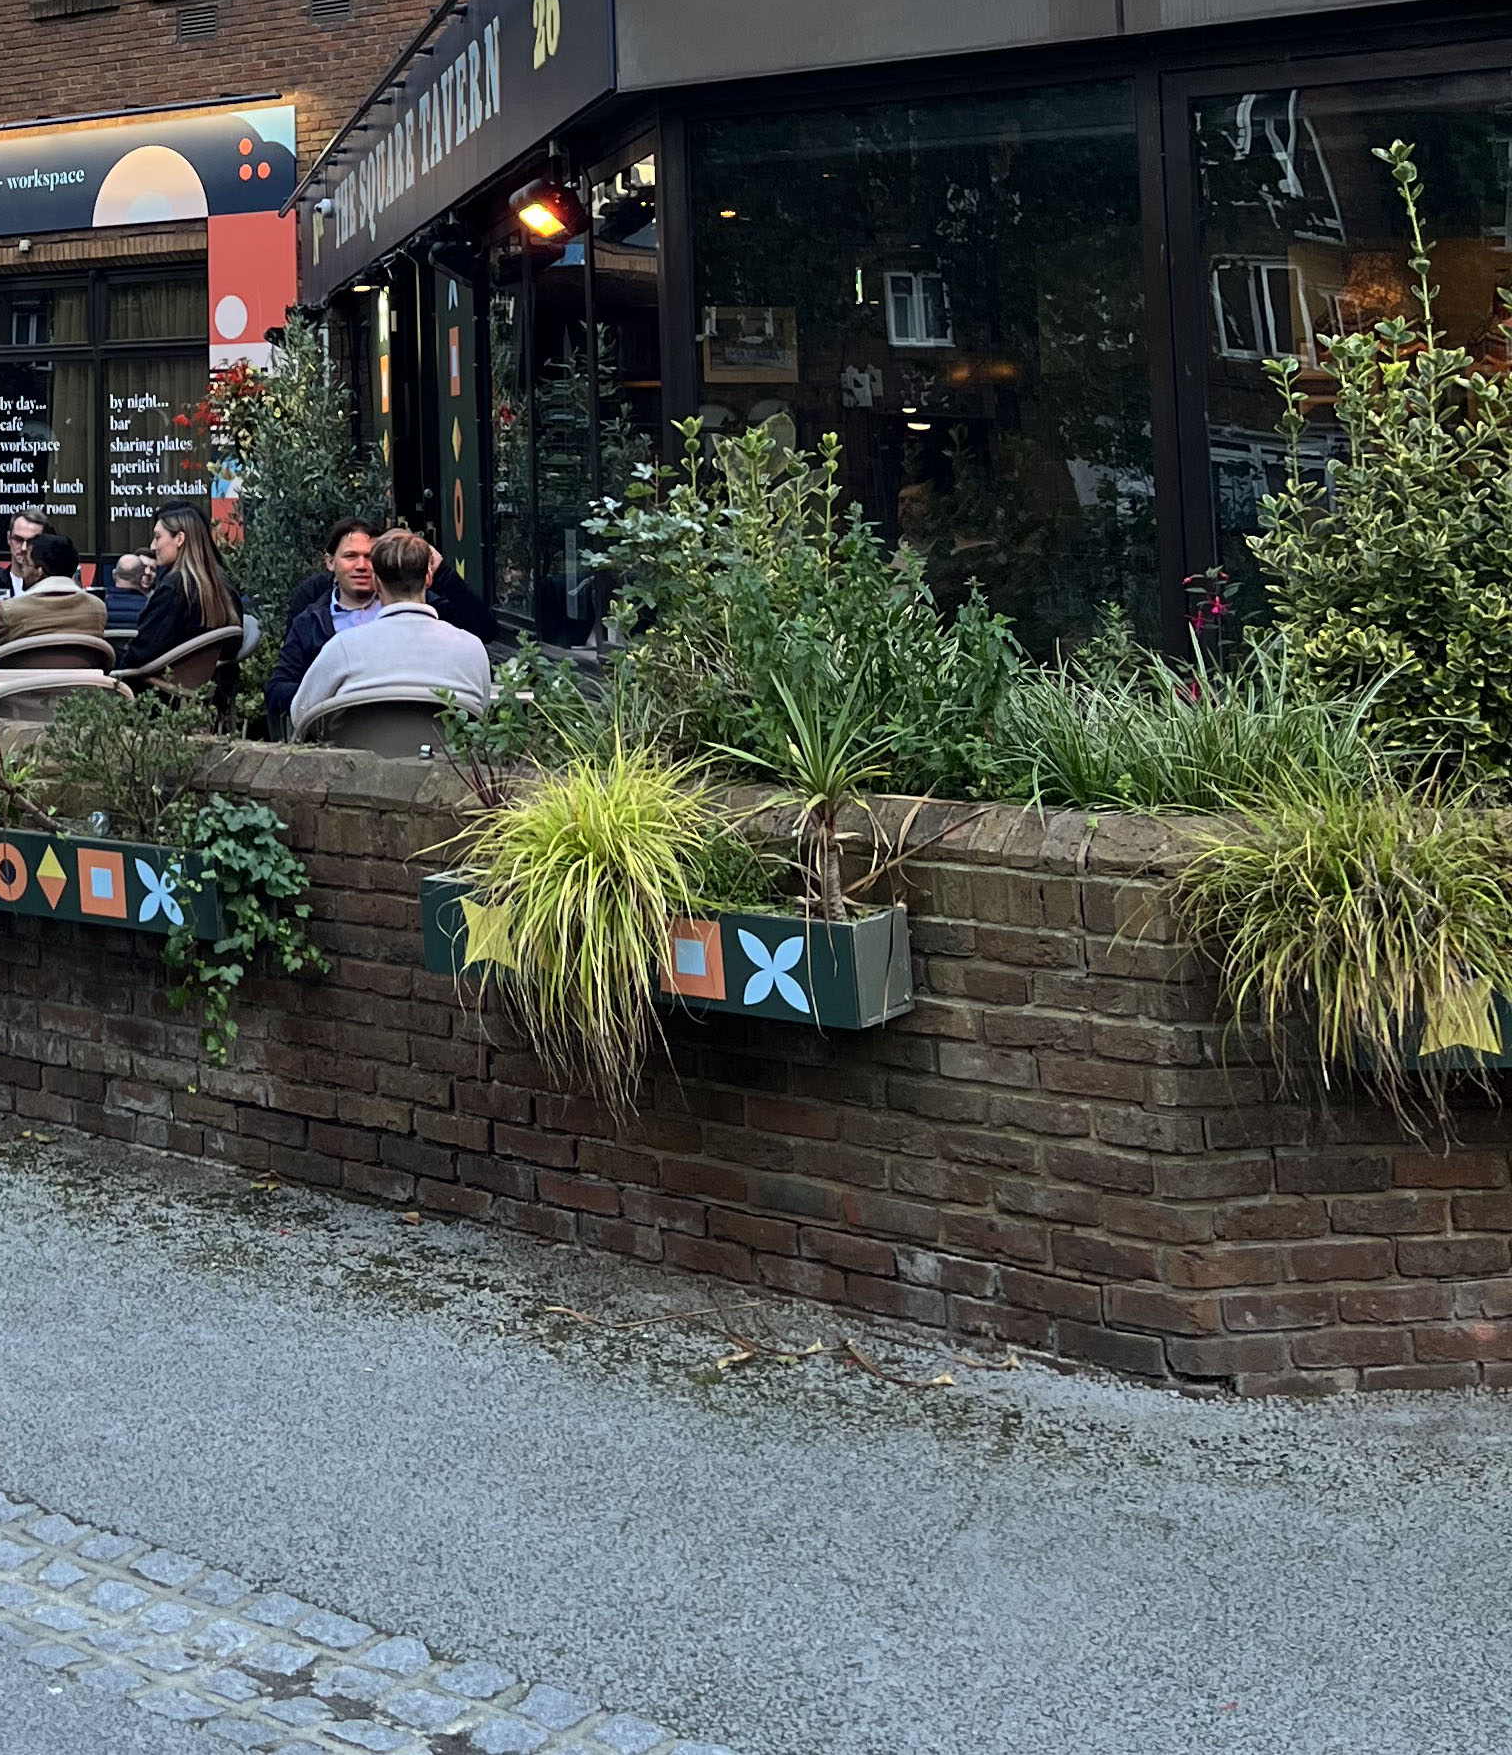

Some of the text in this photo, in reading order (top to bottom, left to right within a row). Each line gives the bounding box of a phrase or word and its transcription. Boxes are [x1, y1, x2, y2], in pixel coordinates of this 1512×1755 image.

[334, 15, 501, 250] THE SQUARE TAVERN
[7, 168, 86, 192] workspace
[0, 396, 14, 415] by
[109, 393, 124, 413] by
[0, 416, 24, 432] café
[109, 415, 131, 431] bar
[0, 437, 61, 457] workspace
[109, 435, 193, 456] sharing plates
[0, 457, 34, 473] coffee
[110, 458, 160, 479] aperitivi
[0, 478, 39, 494] brunch
[53, 478, 84, 494] lunch
[110, 479, 143, 496] beers
[156, 478, 208, 496] cocktails
[46, 504, 77, 515] room
[110, 502, 153, 522] private
